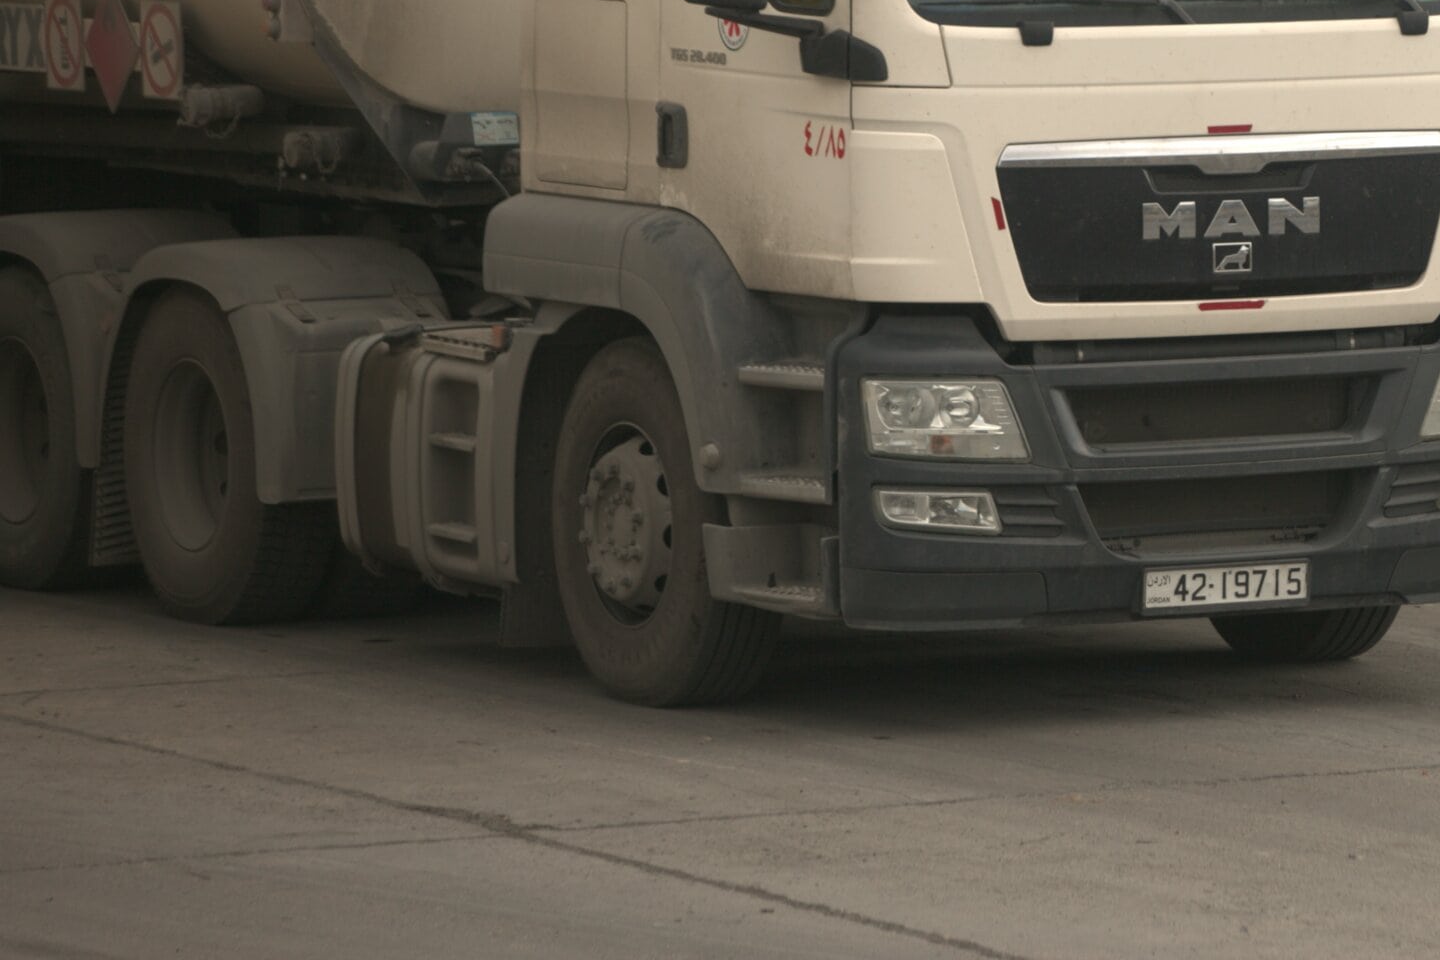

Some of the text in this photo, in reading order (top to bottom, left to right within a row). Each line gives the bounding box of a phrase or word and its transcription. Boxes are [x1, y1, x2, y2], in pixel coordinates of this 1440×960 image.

[1142, 196, 1320, 239] MAN
[1147, 596, 1171, 604] JORDAN
[1174, 567, 1301, 602] 42-19715
